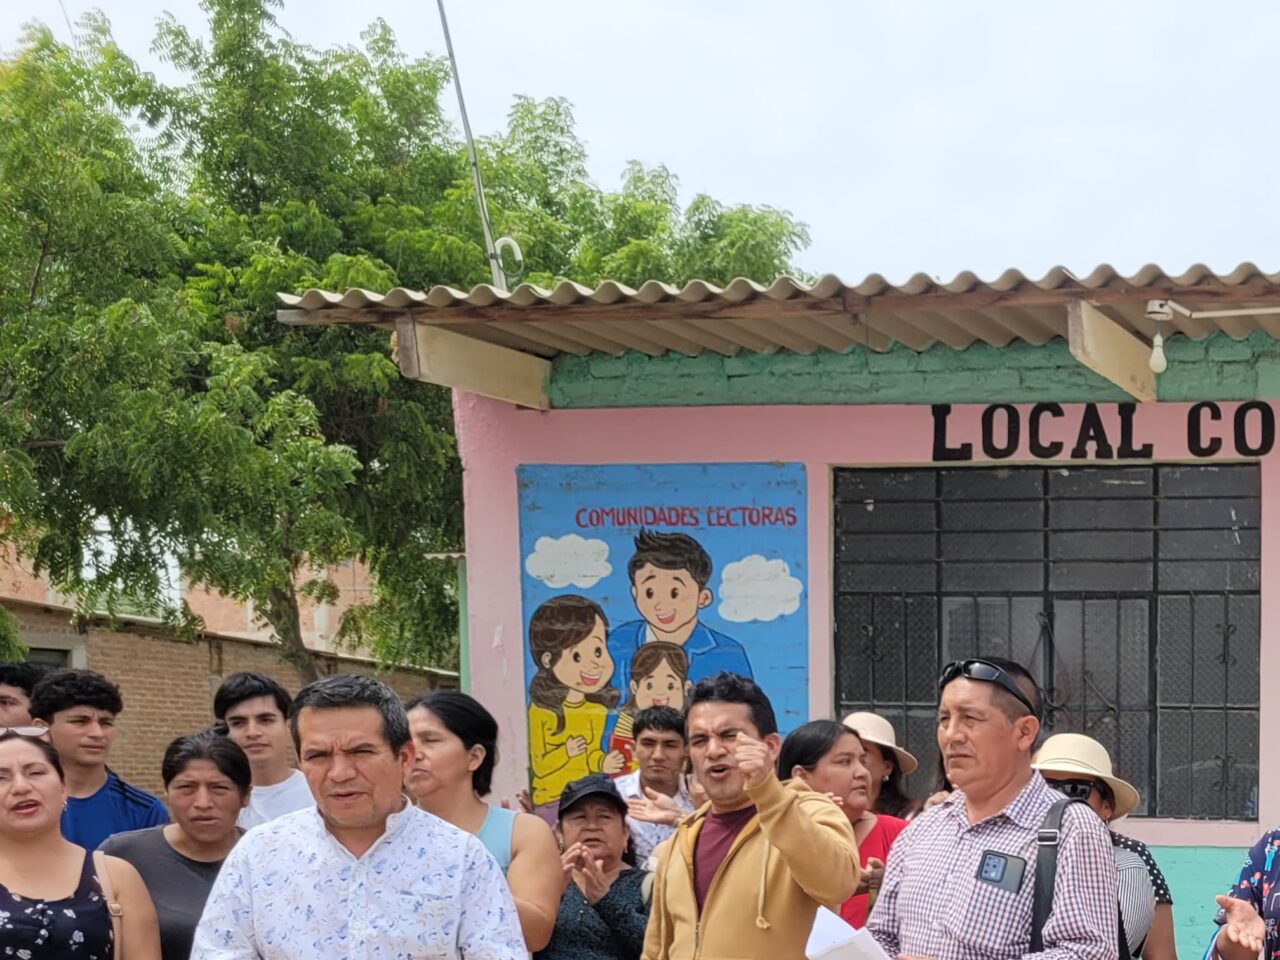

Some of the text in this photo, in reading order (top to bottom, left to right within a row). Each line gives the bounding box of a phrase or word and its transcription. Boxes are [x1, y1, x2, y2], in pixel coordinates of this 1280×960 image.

[931, 402, 1154, 461] LOCAL
[575, 505, 798, 528] COMUNIDADES LECTORAS
